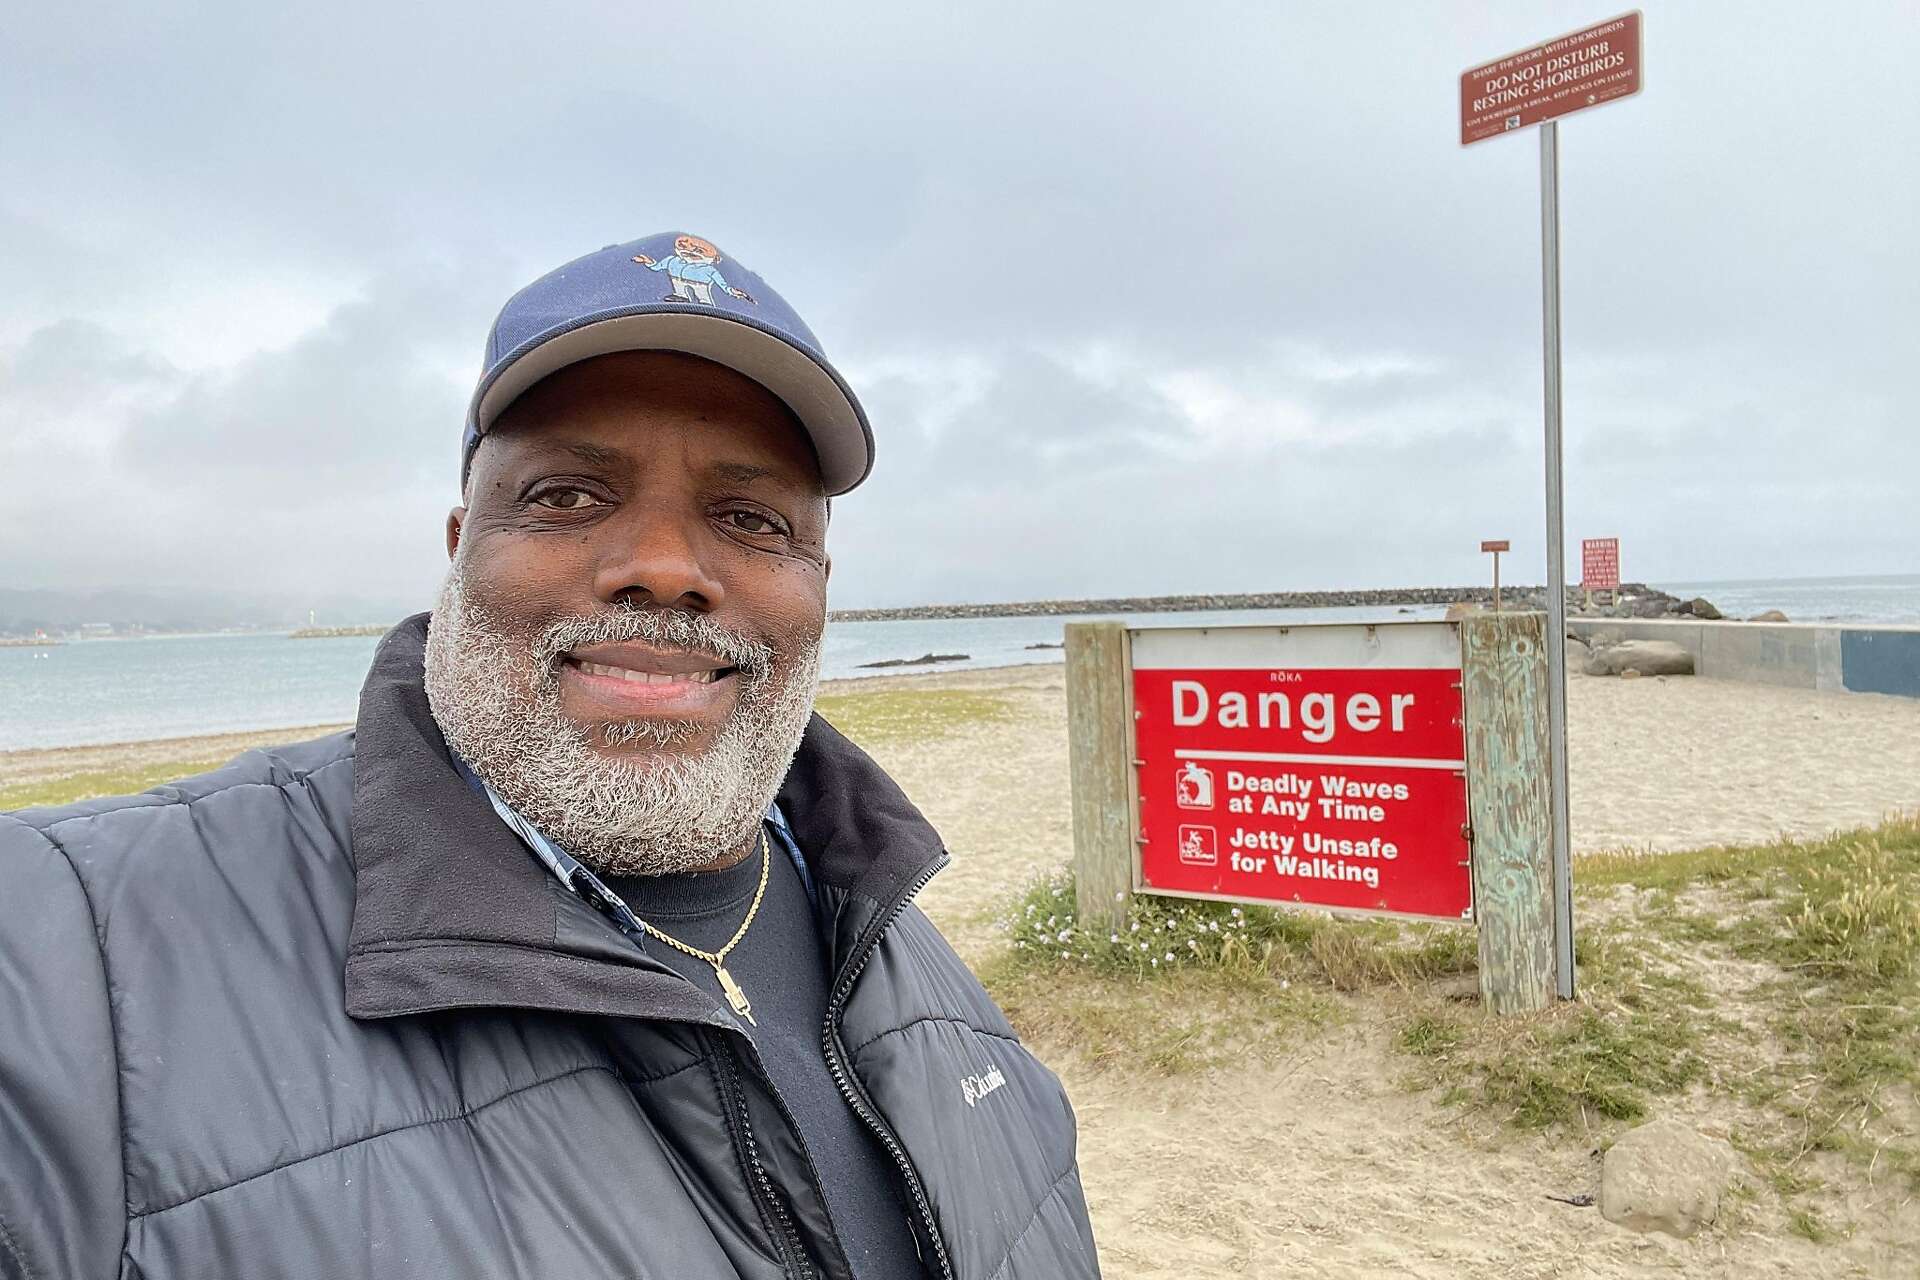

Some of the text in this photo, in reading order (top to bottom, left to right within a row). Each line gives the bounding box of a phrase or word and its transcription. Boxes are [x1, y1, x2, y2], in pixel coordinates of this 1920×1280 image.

[1545, 40, 1568, 55] WITH
[1473, 82, 1529, 113] RESTING
[1532, 51, 1624, 93] SHOREBIRDS
[1486, 41, 1609, 94] DO NOT DISTURB
[1171, 680, 1415, 743] Danger
[1227, 771, 1409, 800] Deadly Waves
[1229, 795, 1385, 822] at Any Time
[1230, 828, 1398, 859] Jetty Unsafe
[1231, 852, 1379, 888] for Walking
